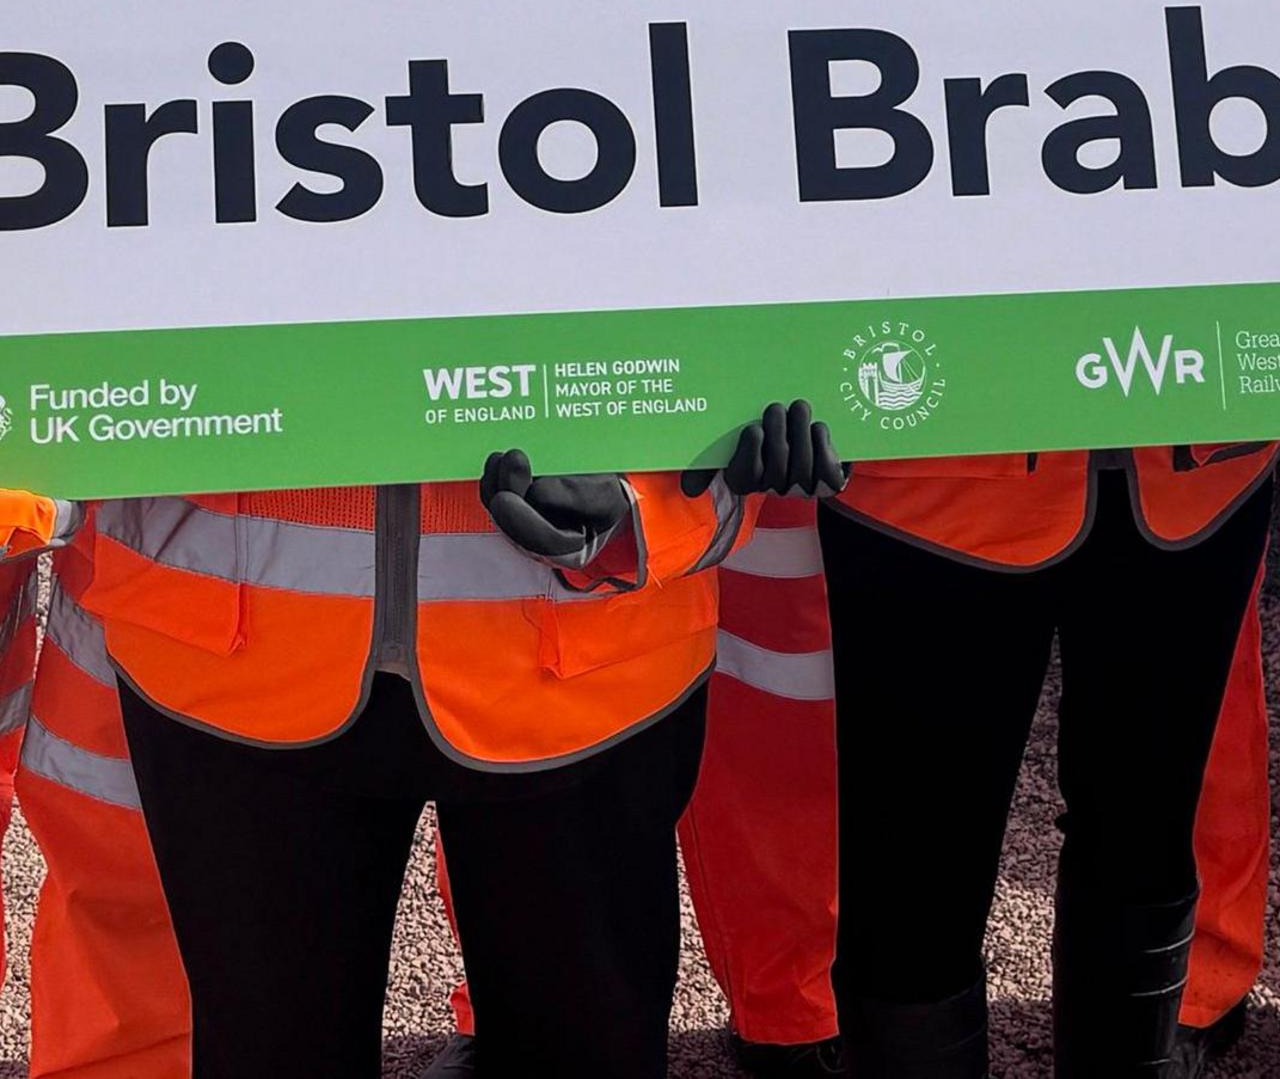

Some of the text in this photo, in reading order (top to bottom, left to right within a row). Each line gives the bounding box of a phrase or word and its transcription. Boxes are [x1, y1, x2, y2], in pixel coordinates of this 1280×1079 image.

[843, 321, 936, 360] BRISTOL
[554, 358, 680, 378] HELEN GODWIN
[1075, 325, 1206, 398] GWR
[30, 379, 198, 411] Funded by
[422, 364, 537, 401] WEST
[555, 378, 673, 398] MAYOR OF THE
[425, 405, 536, 424] OF ENGLAND
[556, 397, 708, 418] WEST OF ENGLAND
[840, 379, 946, 430] CITY COUNCIL
[30, 408, 283, 444] UK Government
